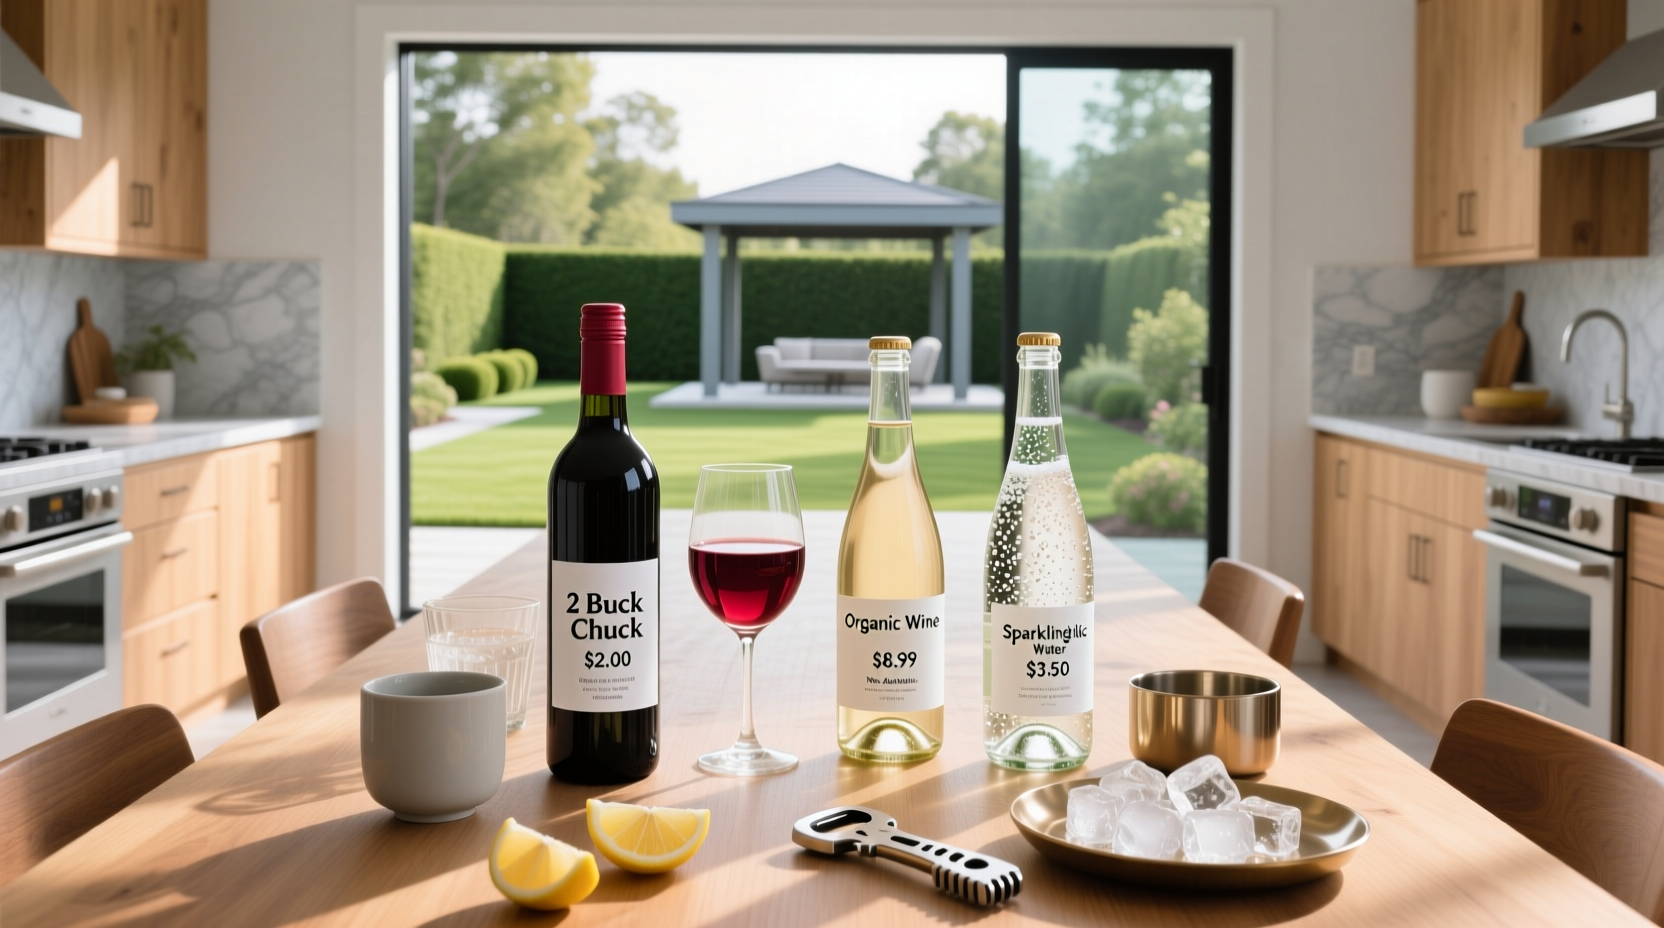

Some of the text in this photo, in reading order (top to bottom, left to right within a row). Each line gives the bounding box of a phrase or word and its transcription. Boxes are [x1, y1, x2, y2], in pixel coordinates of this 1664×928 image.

[566, 591, 644, 614] 2 Buck
[571, 617, 644, 640] Chuck
[845, 612, 940, 634] Organic Wine
[584, 650, 631, 670] $2.00
[873, 651, 917, 669] $8.99
[1026, 660, 1070, 679] $3.50
